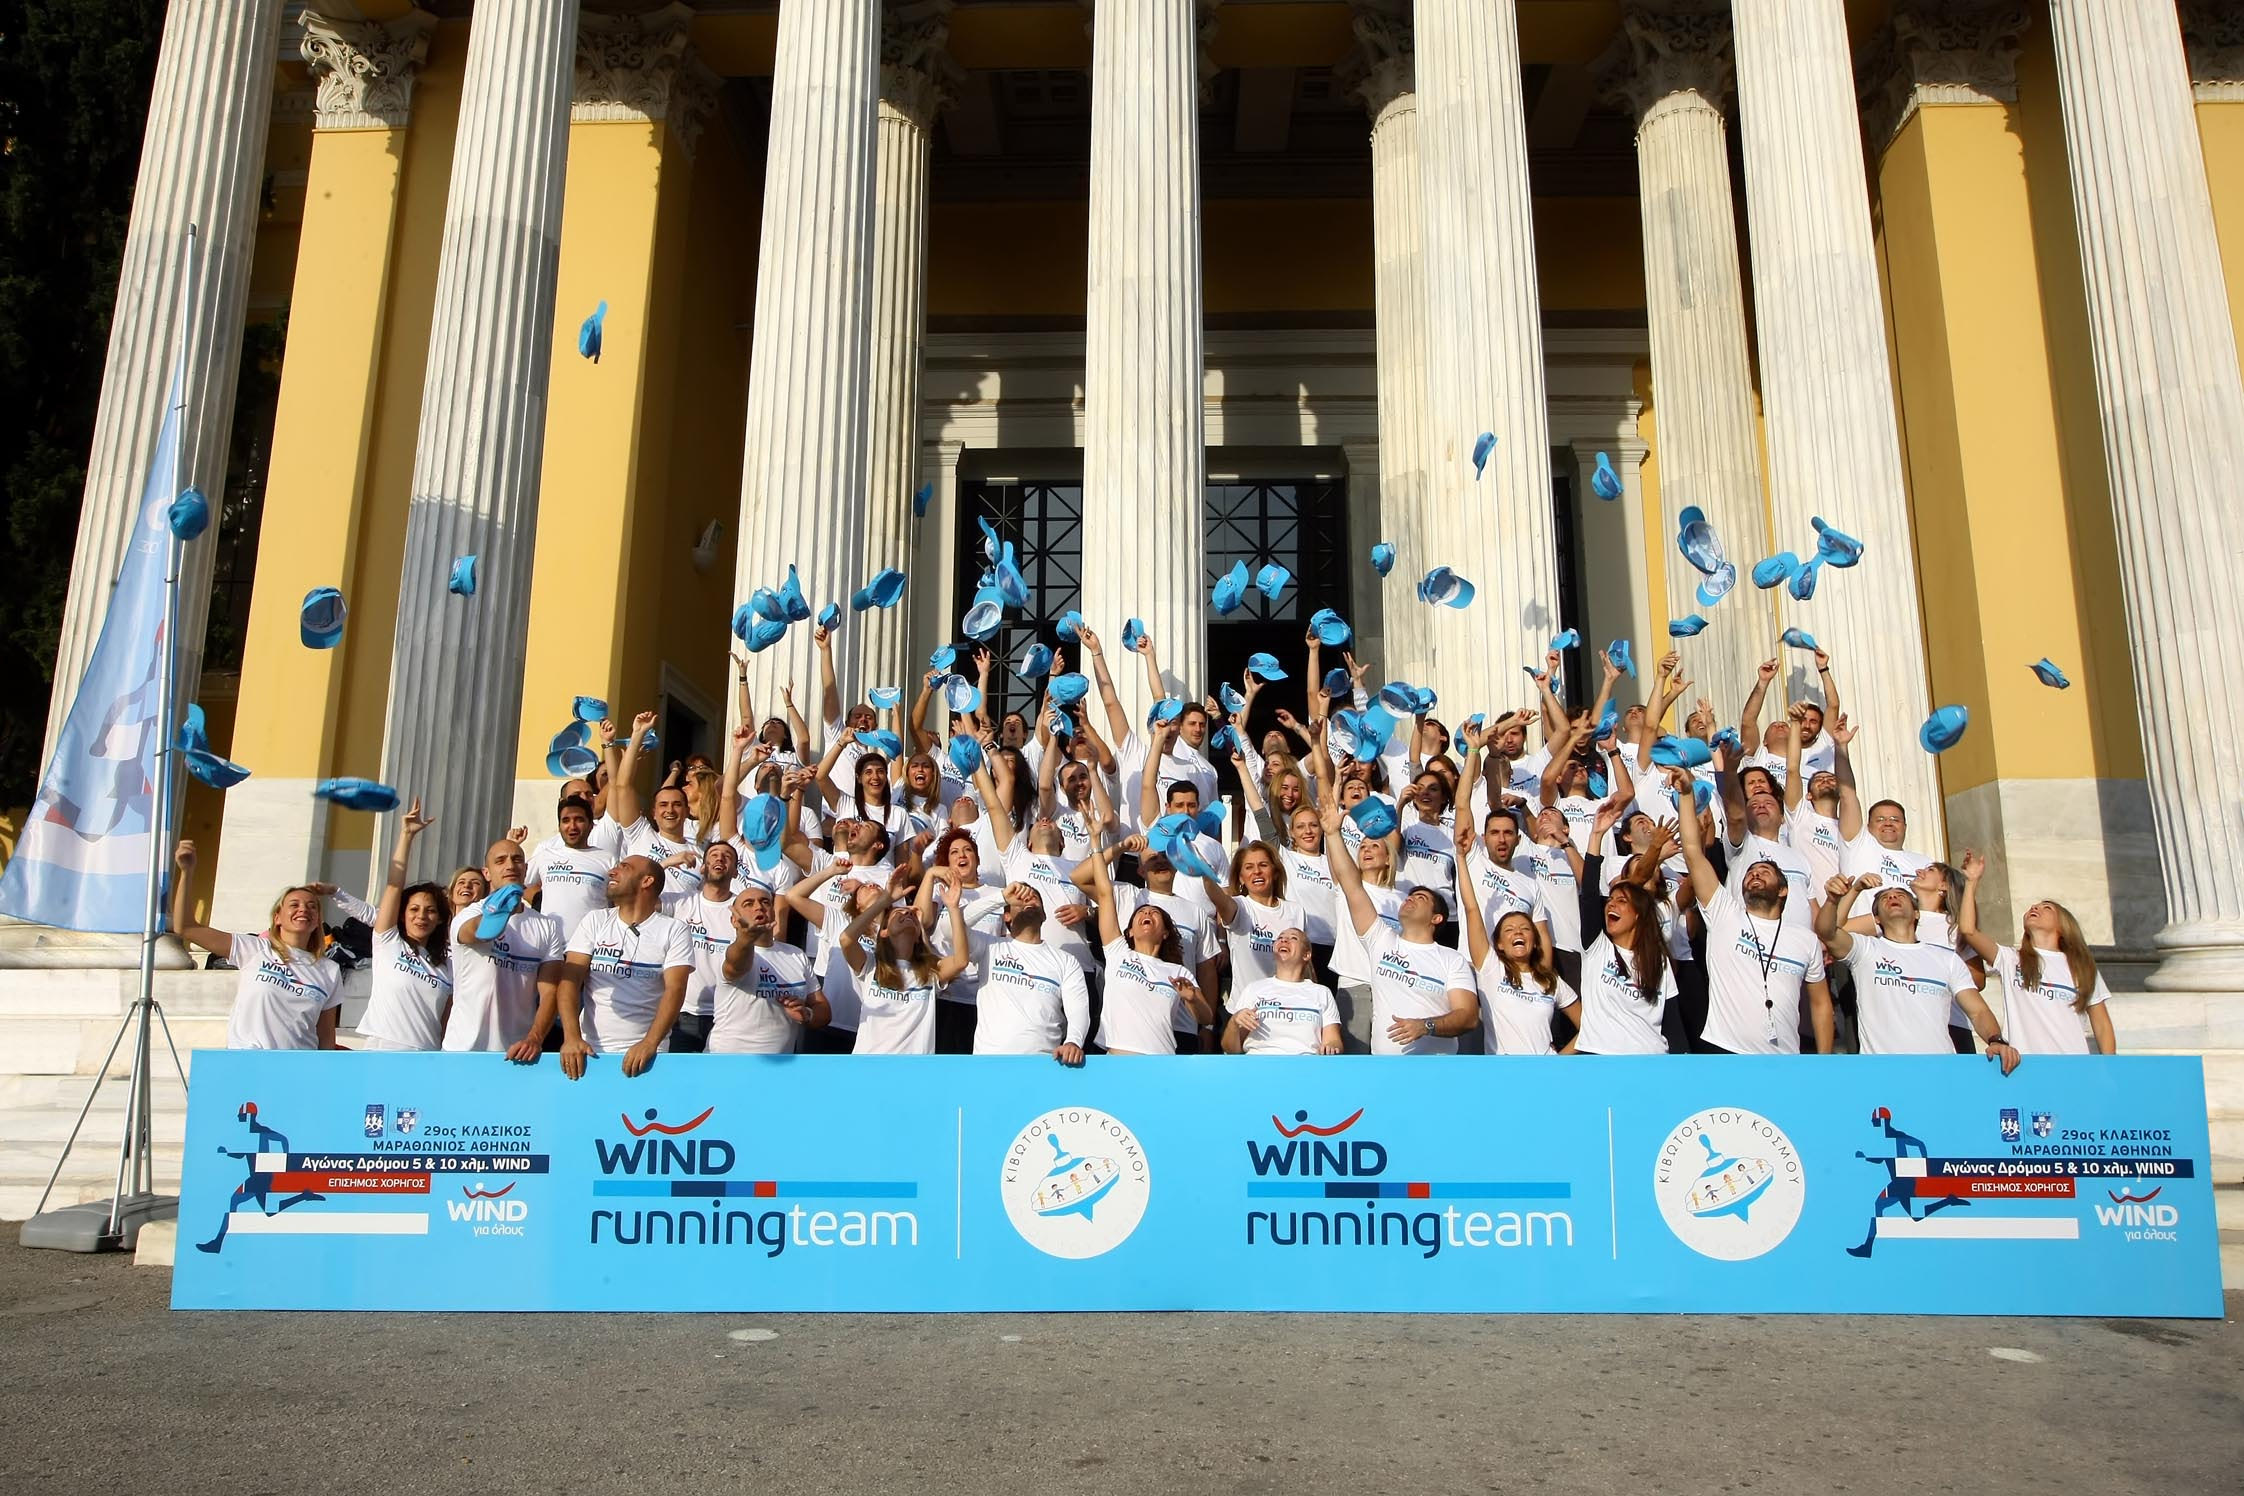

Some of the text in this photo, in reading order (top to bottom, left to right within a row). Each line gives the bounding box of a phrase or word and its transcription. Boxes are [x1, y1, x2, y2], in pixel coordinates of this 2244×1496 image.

[995, 959, 1024, 971] WIND
[1382, 952, 1410, 968] WIND
[262, 960, 294, 977] WIND
[1376, 966, 1444, 995] runningteam
[423, 1125, 531, 1138] 29ος ΚΛΑΣΙΚΟΣ
[2061, 1129, 2171, 1142] 29ος ΚΛΑΣΙΚΟΣ
[373, 1140, 531, 1152] ΜΑΡΑΘΩΝΙΟΣ ΑΘΗΝΩΝ
[1006, 1112, 1145, 1183] ΚΙΒΩΤΟΣ ΤΟΥ ΚΟΣΜΟΥ
[1659, 1112, 1800, 1184] ΚΙΒΩΤΟΣ ΤΟΥ ΚΟΣΜΟΥ
[2011, 1145, 2172, 1157] ΜΑΡΑΘΩΝΙΟΣ ΑΘΗΝΩΝ
[302, 1156, 354, 1172] Αγώνας
[357, 1156, 409, 1171] Δρόμου
[413, 1157, 421, 1170] 5
[425, 1157, 436, 1170] &
[440, 1157, 456, 1170] 10
[492, 1157, 531, 1170] WIND
[595, 1139, 735, 1175] WIND
[1247, 1140, 1387, 1177] WIND
[1942, 1161, 1995, 1176] Αγώνας
[1998, 1161, 2051, 1176] Δρόμου
[2054, 1163, 2063, 1174] 5
[2067, 1163, 2078, 1174] &
[2082, 1163, 2099, 1174] 10
[2136, 1163, 2174, 1175] WIND
[328, 1178, 425, 1188] ΕΠΙΣΗΜΟΣ ΧΟΡΗΓΟΣ
[1971, 1182, 2070, 1193] ΕΠΙΣΗΜΟΣ ΧΟΡΗΓΟΣ
[447, 1200, 528, 1222] WIND
[2095, 1205, 2178, 1226] WIND
[473, 1223, 524, 1236] για όλους
[2124, 1228, 2177, 1242] για όλους
